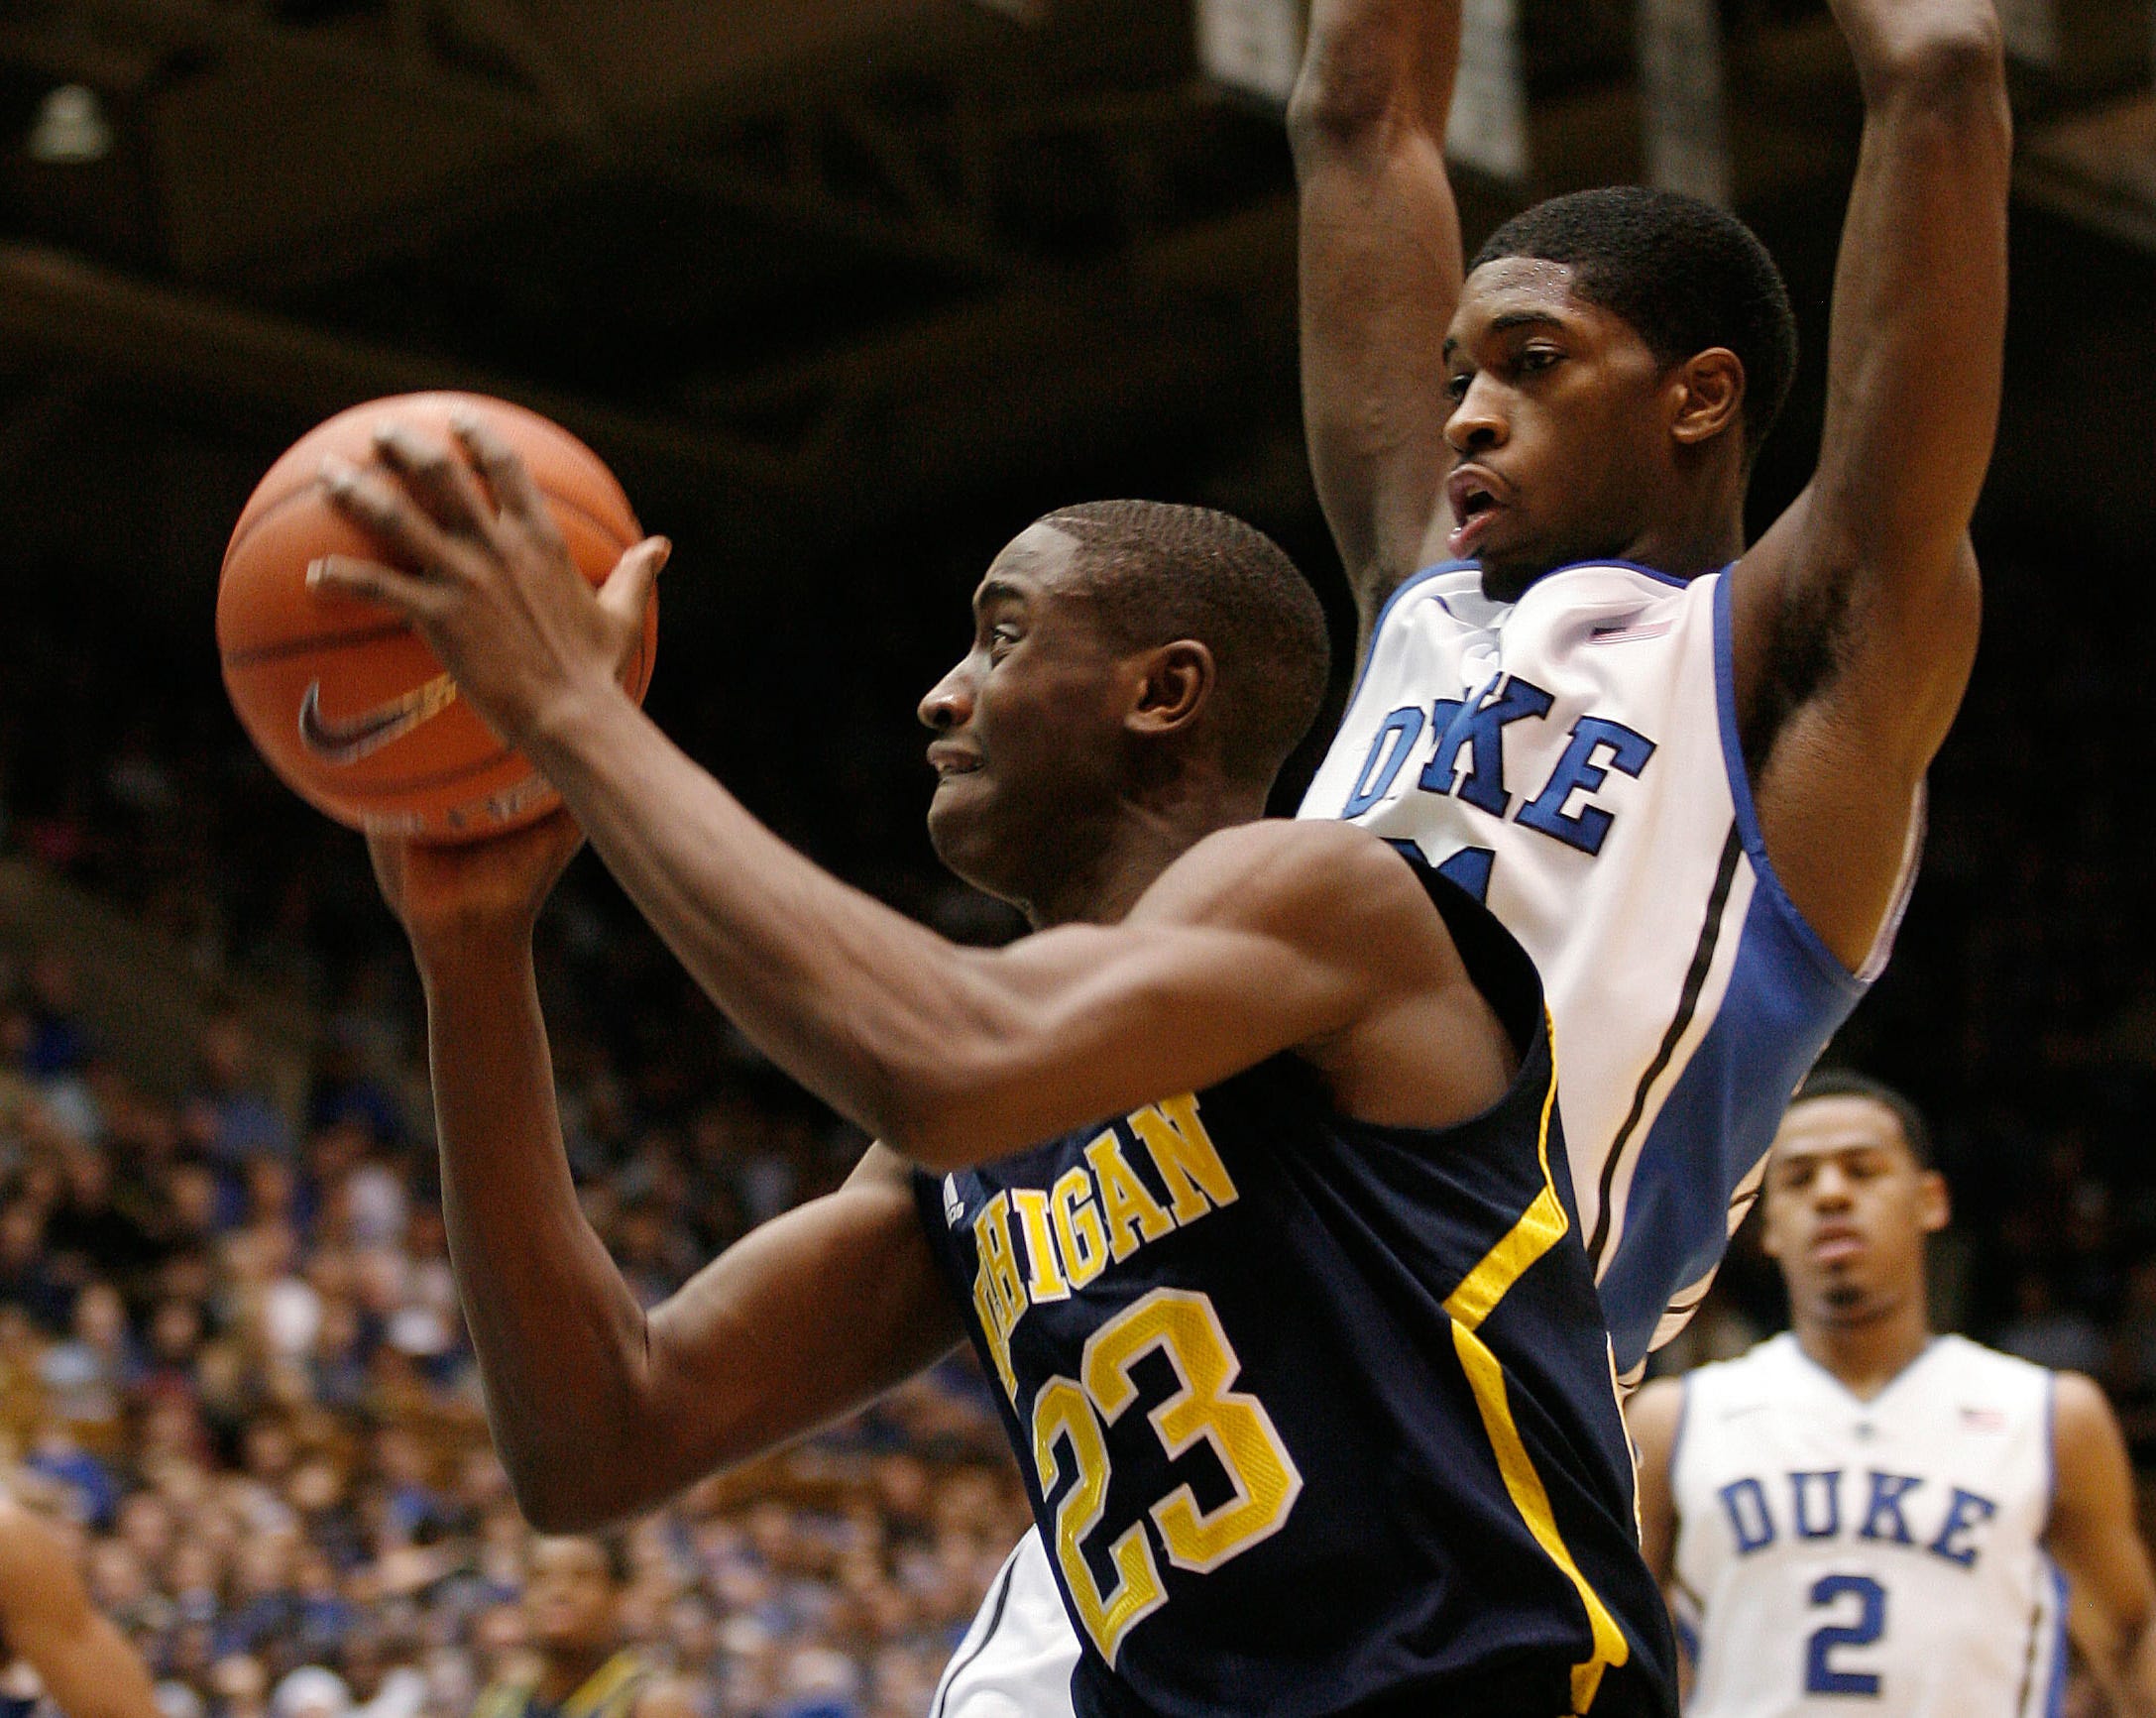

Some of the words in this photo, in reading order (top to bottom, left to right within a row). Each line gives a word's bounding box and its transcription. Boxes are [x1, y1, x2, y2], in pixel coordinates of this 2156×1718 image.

[1342, 670, 1657, 858] DKE
[1032, 1286, 1305, 1672] 23
[1718, 1470, 1997, 1567] DUKE
[1805, 1574, 1887, 1694] 2
